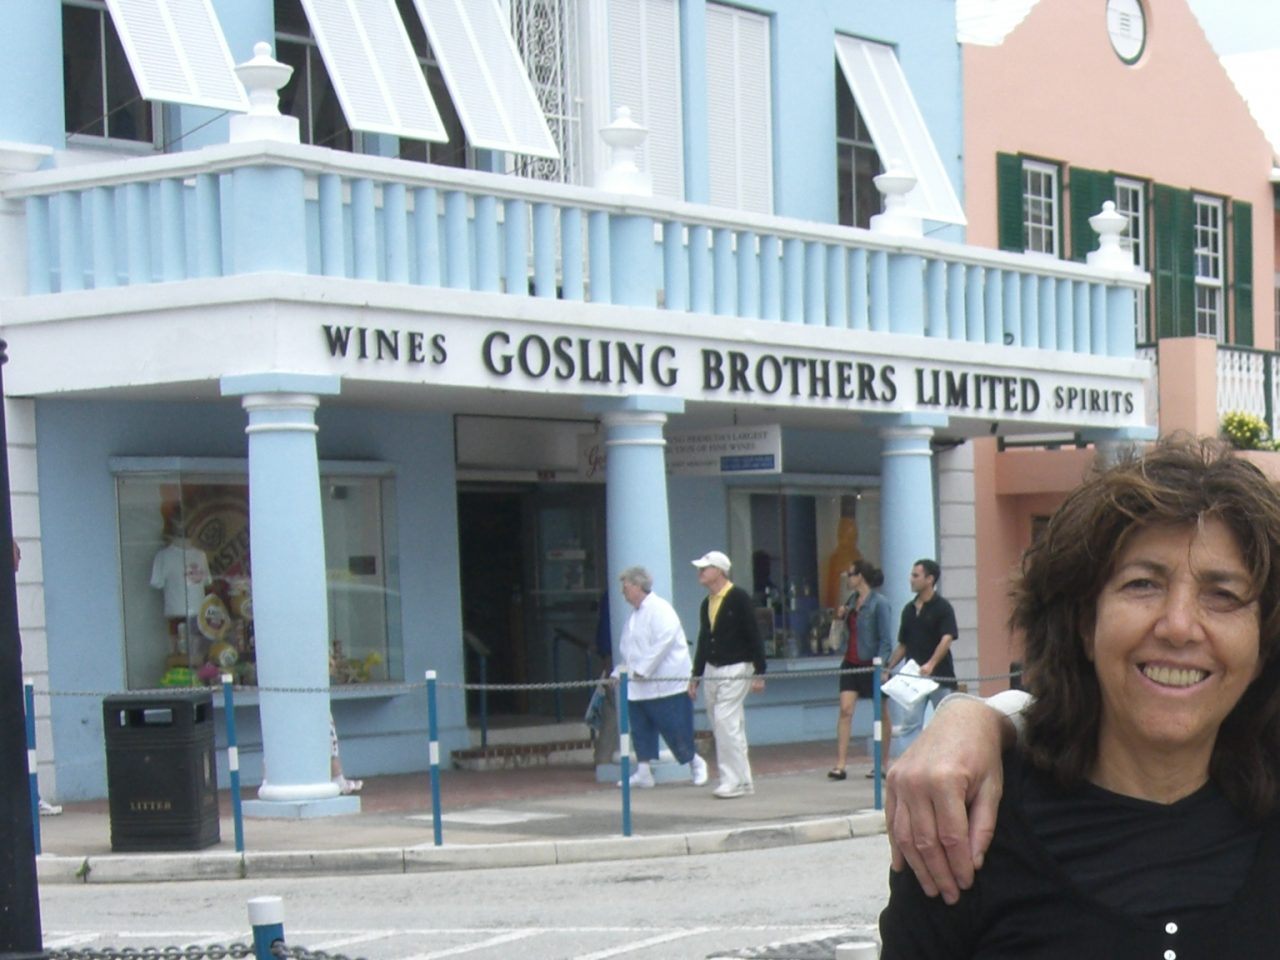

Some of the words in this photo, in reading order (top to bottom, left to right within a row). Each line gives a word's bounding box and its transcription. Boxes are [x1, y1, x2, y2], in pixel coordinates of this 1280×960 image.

[322, 325, 448, 364] WINES
[481, 331, 679, 387] GOSLING
[700, 349, 897, 402] BROTHERS
[915, 368, 1041, 413] LIMITED
[1054, 386, 1135, 414] SPIRITS
